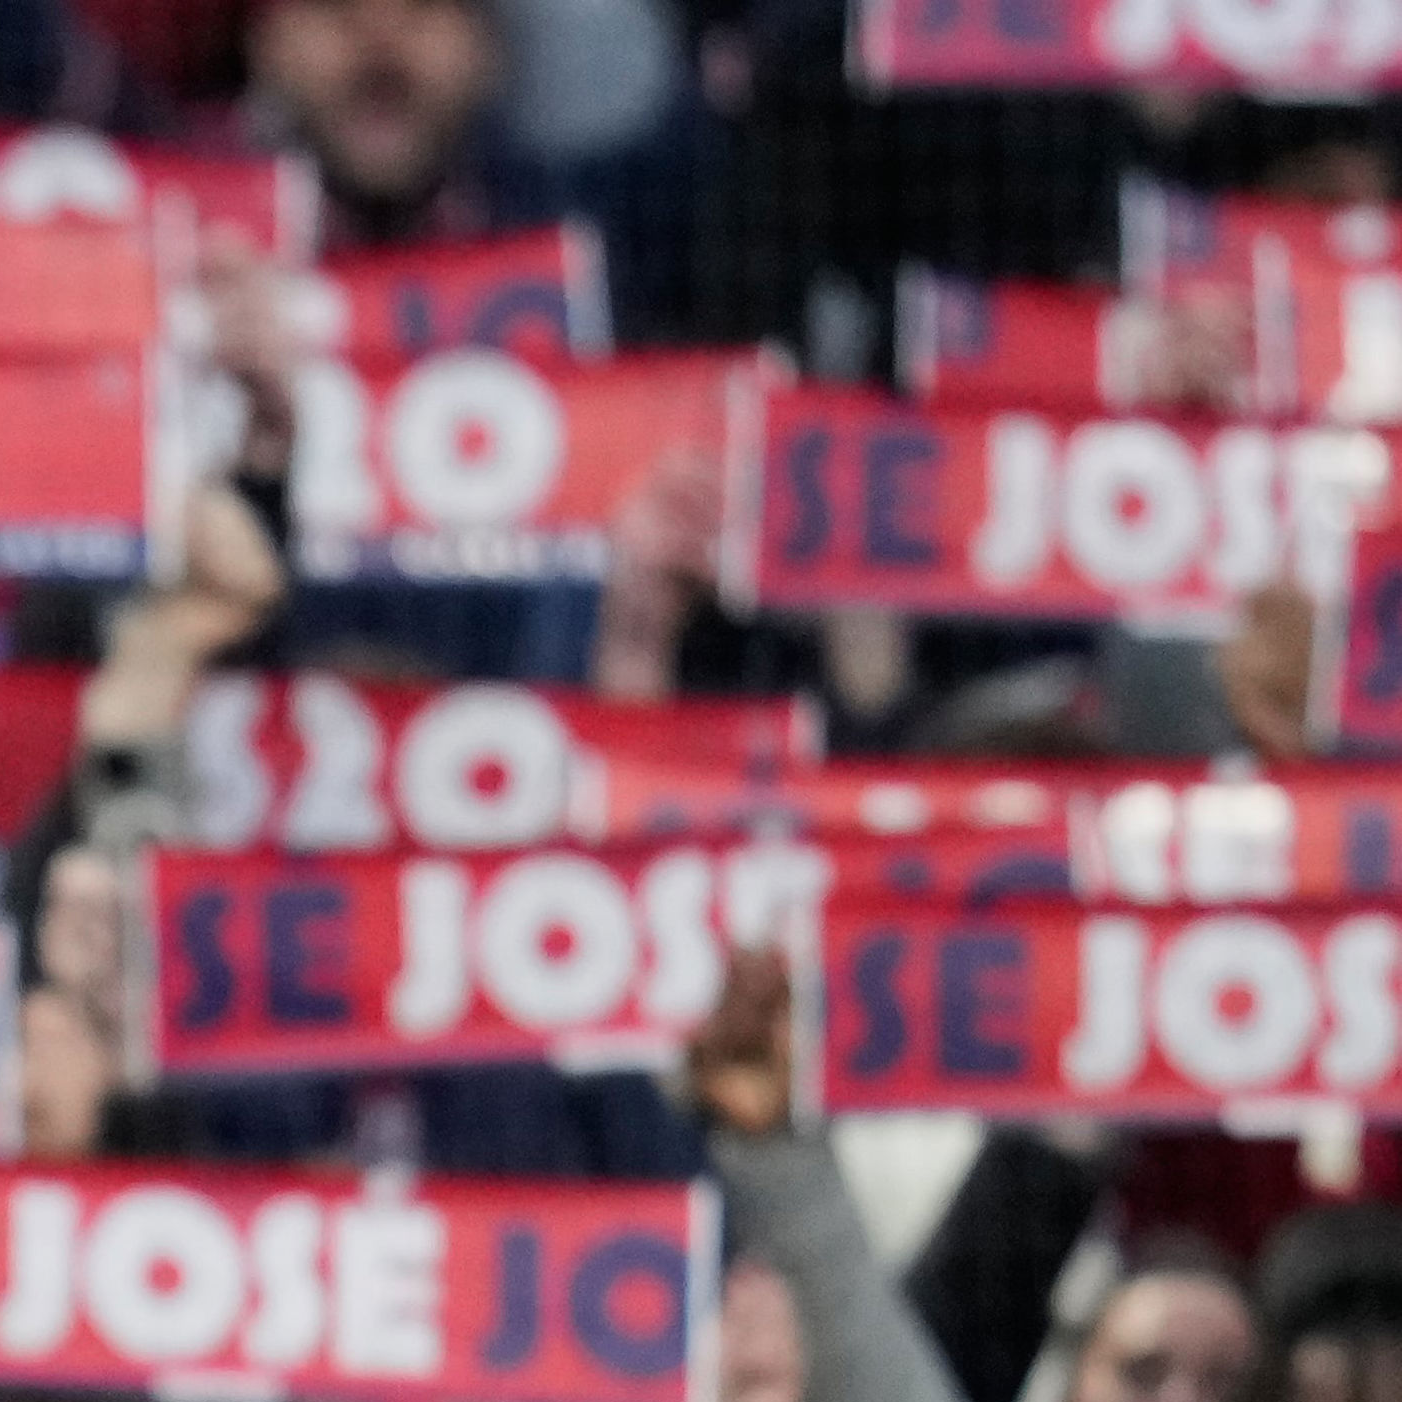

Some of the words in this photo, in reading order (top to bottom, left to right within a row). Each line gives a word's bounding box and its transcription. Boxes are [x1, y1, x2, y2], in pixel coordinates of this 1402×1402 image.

[784, 429, 942, 567] SE
[178, 886, 347, 1030] SE
[848, 927, 1027, 1079] SE
[480, 1227, 688, 1374] JO
